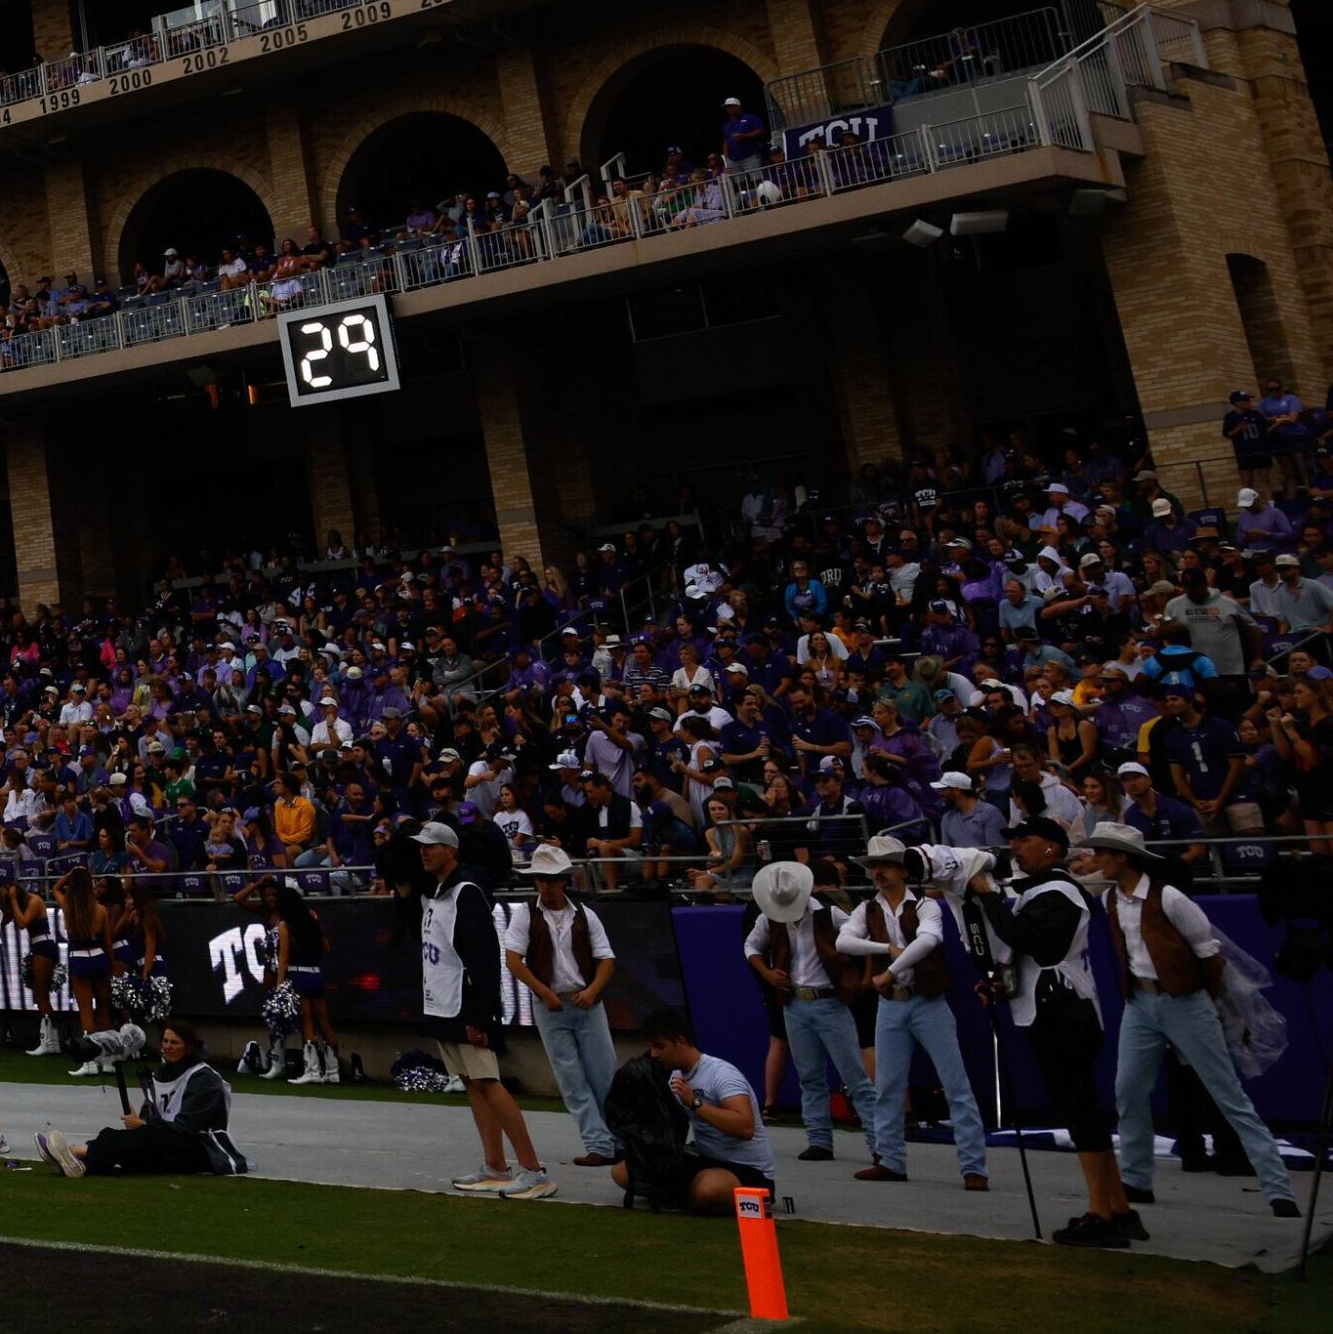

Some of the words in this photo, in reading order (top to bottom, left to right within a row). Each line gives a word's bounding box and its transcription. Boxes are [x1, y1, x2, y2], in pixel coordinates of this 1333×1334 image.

[39, 89, 80, 114] 1999
[109, 70, 152, 95] 2000
[183, 48, 230, 74] 2002
[260, 28, 308, 53] 2005
[341, 2, 392, 30] 2009
[300, 314, 380, 388] 29
[1190, 739, 1209, 773] 1
[1237, 844, 1264, 859] TCU
[184, 877, 200, 887] TCU
[208, 923, 270, 1005] TC
[422, 938, 440, 966] CU
[740, 1201, 759, 1212] TCU
